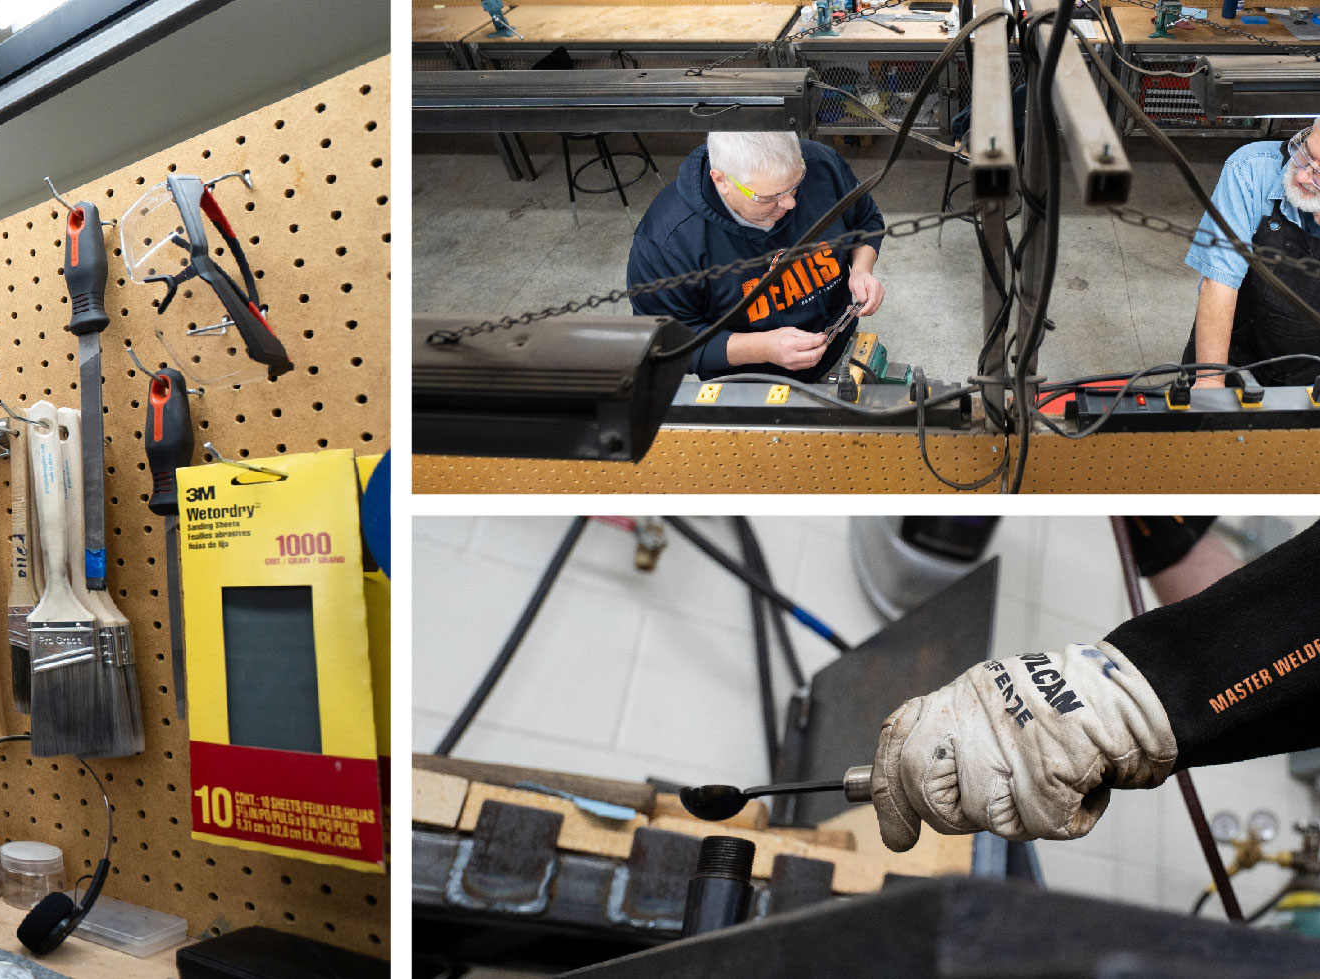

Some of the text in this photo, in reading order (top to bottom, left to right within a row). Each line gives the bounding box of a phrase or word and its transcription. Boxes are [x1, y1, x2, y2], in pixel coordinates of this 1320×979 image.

[186, 485, 216, 502] 3M
[186, 504, 255, 521] Wetordry
[187, 521, 241, 531] Sanding Sheets
[187, 530, 251, 540] Feuilles abrasives
[188, 542, 206, 550] Hojas
[208, 541, 216, 549] de
[275, 532, 331, 556] 1000
[39, 636, 82, 645] Pro Grade
[1208, 668, 1273, 714] MASTER
[194, 784, 233, 828] 10
